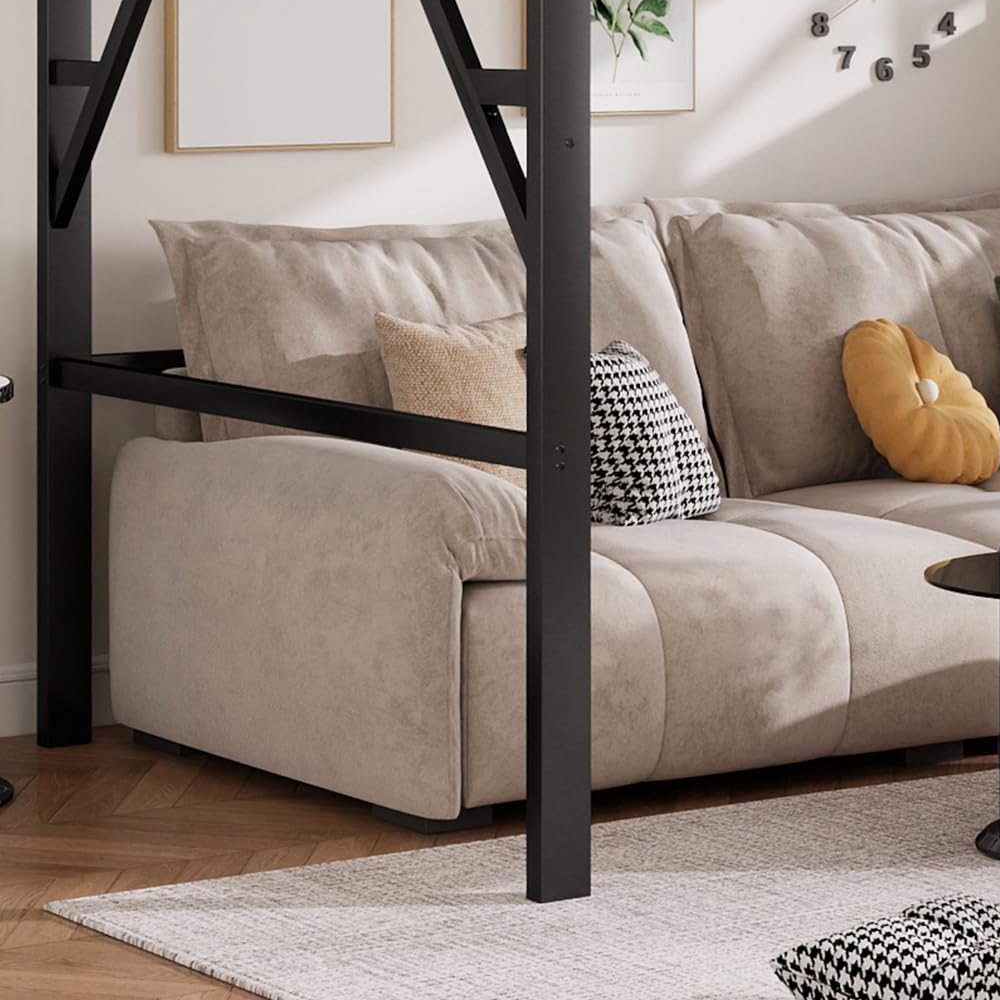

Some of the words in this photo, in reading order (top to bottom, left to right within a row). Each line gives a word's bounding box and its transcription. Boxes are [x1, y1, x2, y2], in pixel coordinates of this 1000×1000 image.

[811, 12, 830, 37] 8
[937, 11, 957, 36] 4
[837, 45, 857, 70] 7
[912, 44, 931, 69] 5
[875, 57, 894, 82] 6
